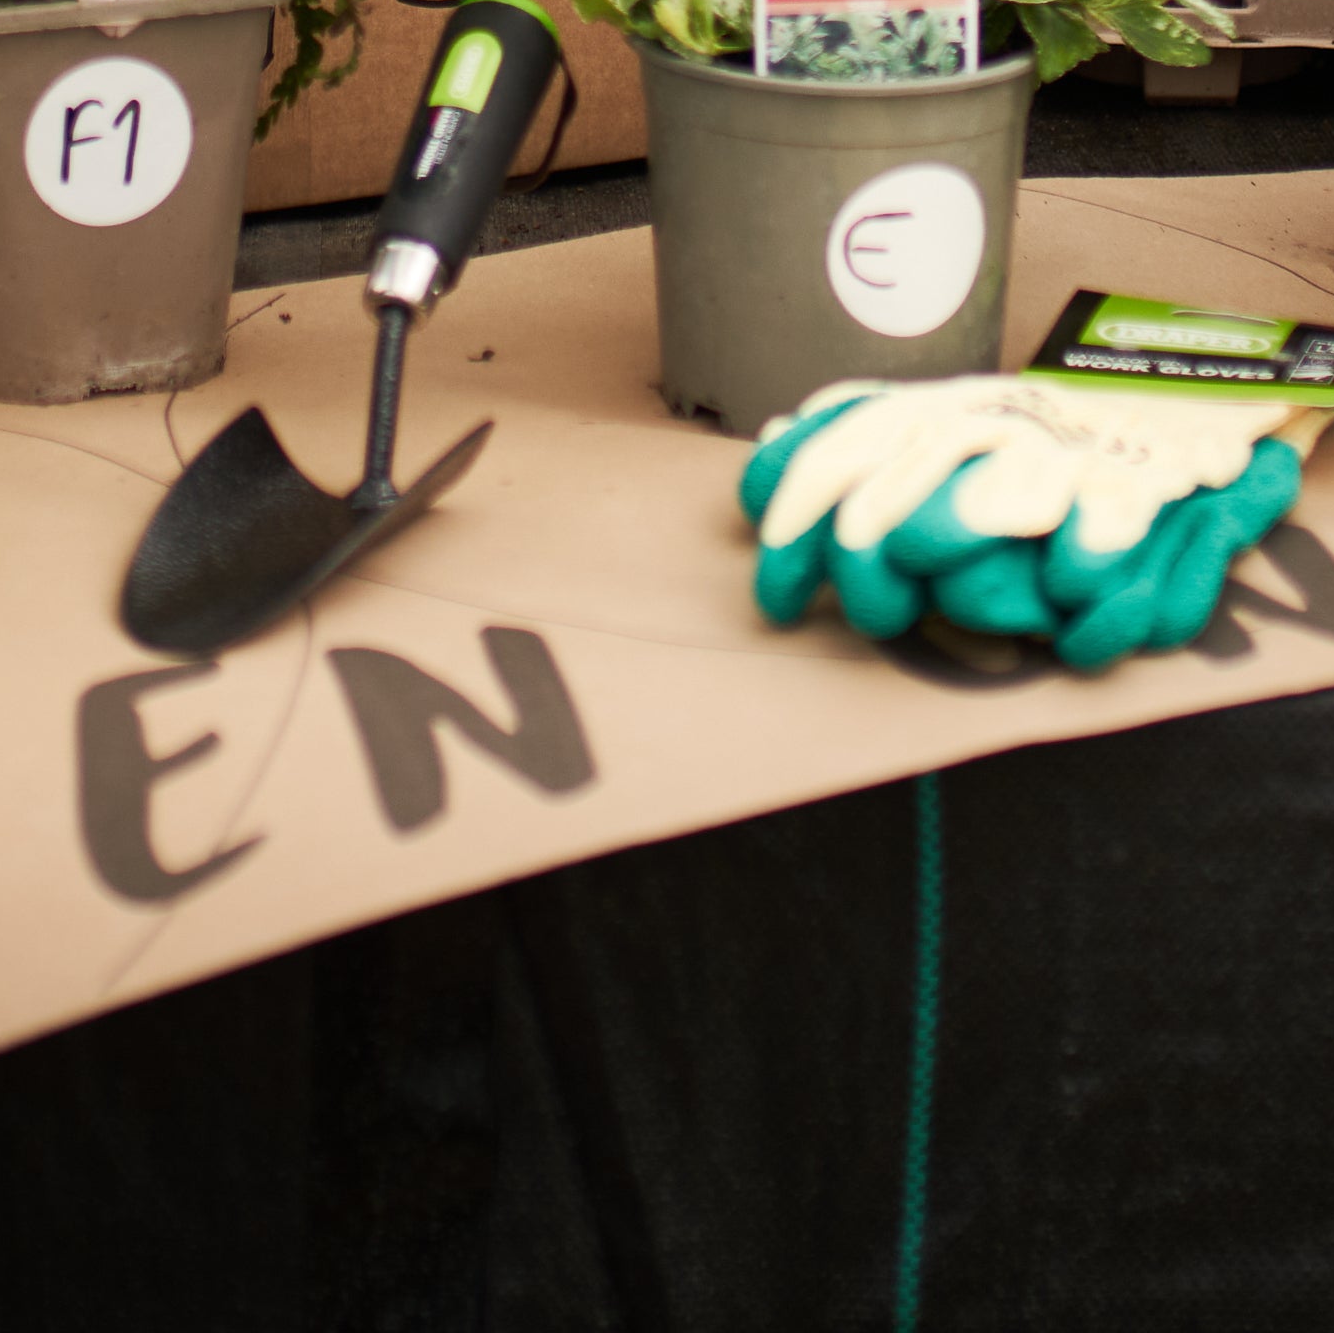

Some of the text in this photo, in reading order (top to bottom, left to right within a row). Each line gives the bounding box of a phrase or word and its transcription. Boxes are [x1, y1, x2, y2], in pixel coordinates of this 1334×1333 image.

[60, 99, 141, 186] F1
[844, 211, 915, 289] E
[1118, 324, 1254, 351] DRAPER
[1065, 358, 1276, 381] WORK GLOVES
